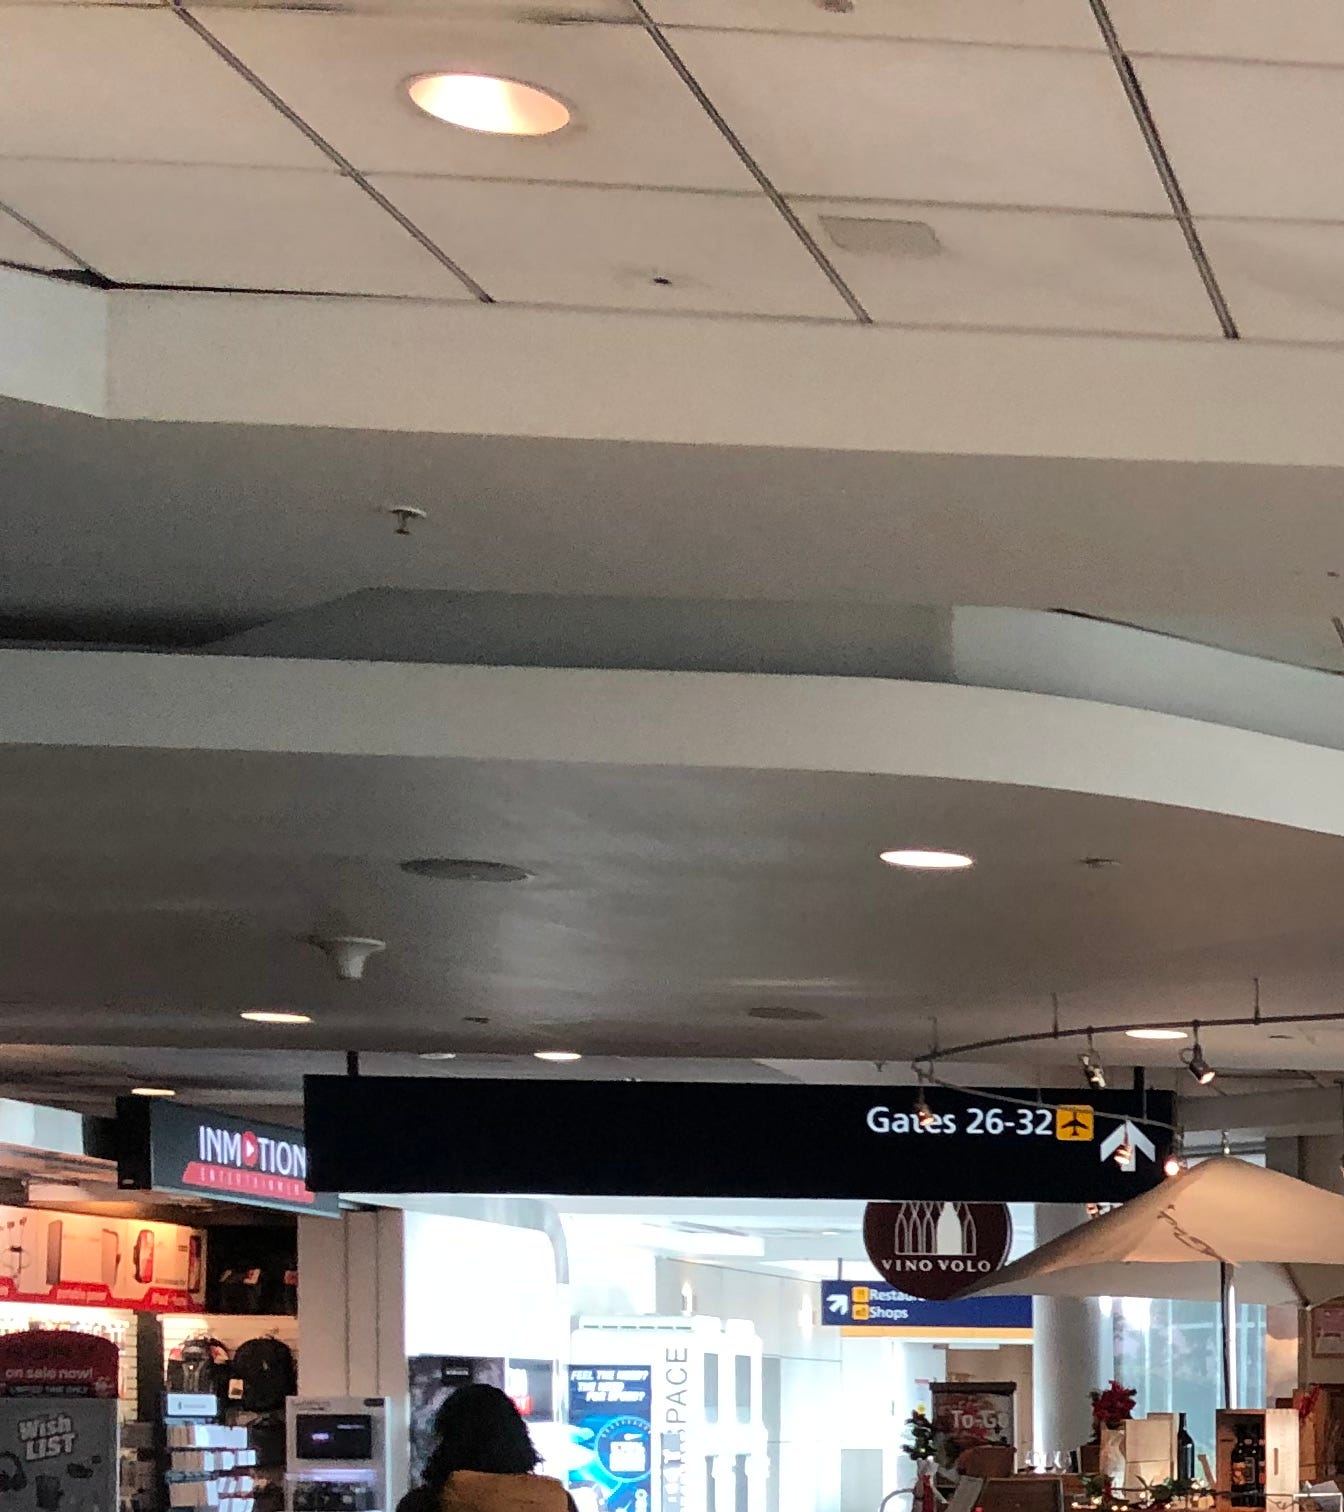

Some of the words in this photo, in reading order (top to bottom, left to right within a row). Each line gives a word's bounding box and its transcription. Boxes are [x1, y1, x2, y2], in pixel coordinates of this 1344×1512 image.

[866, 1105, 957, 1134] Gates
[966, 1107, 1053, 1136] 26-32
[199, 1125, 307, 1179] INMOTION
[200, 1166, 307, 1198] ENTERTAINMEN
[881, 1259, 933, 1272] VINO
[937, 1259, 992, 1273] VOLO
[869, 1306, 909, 1320] Shops
[19, 1414, 72, 1441] Wish
